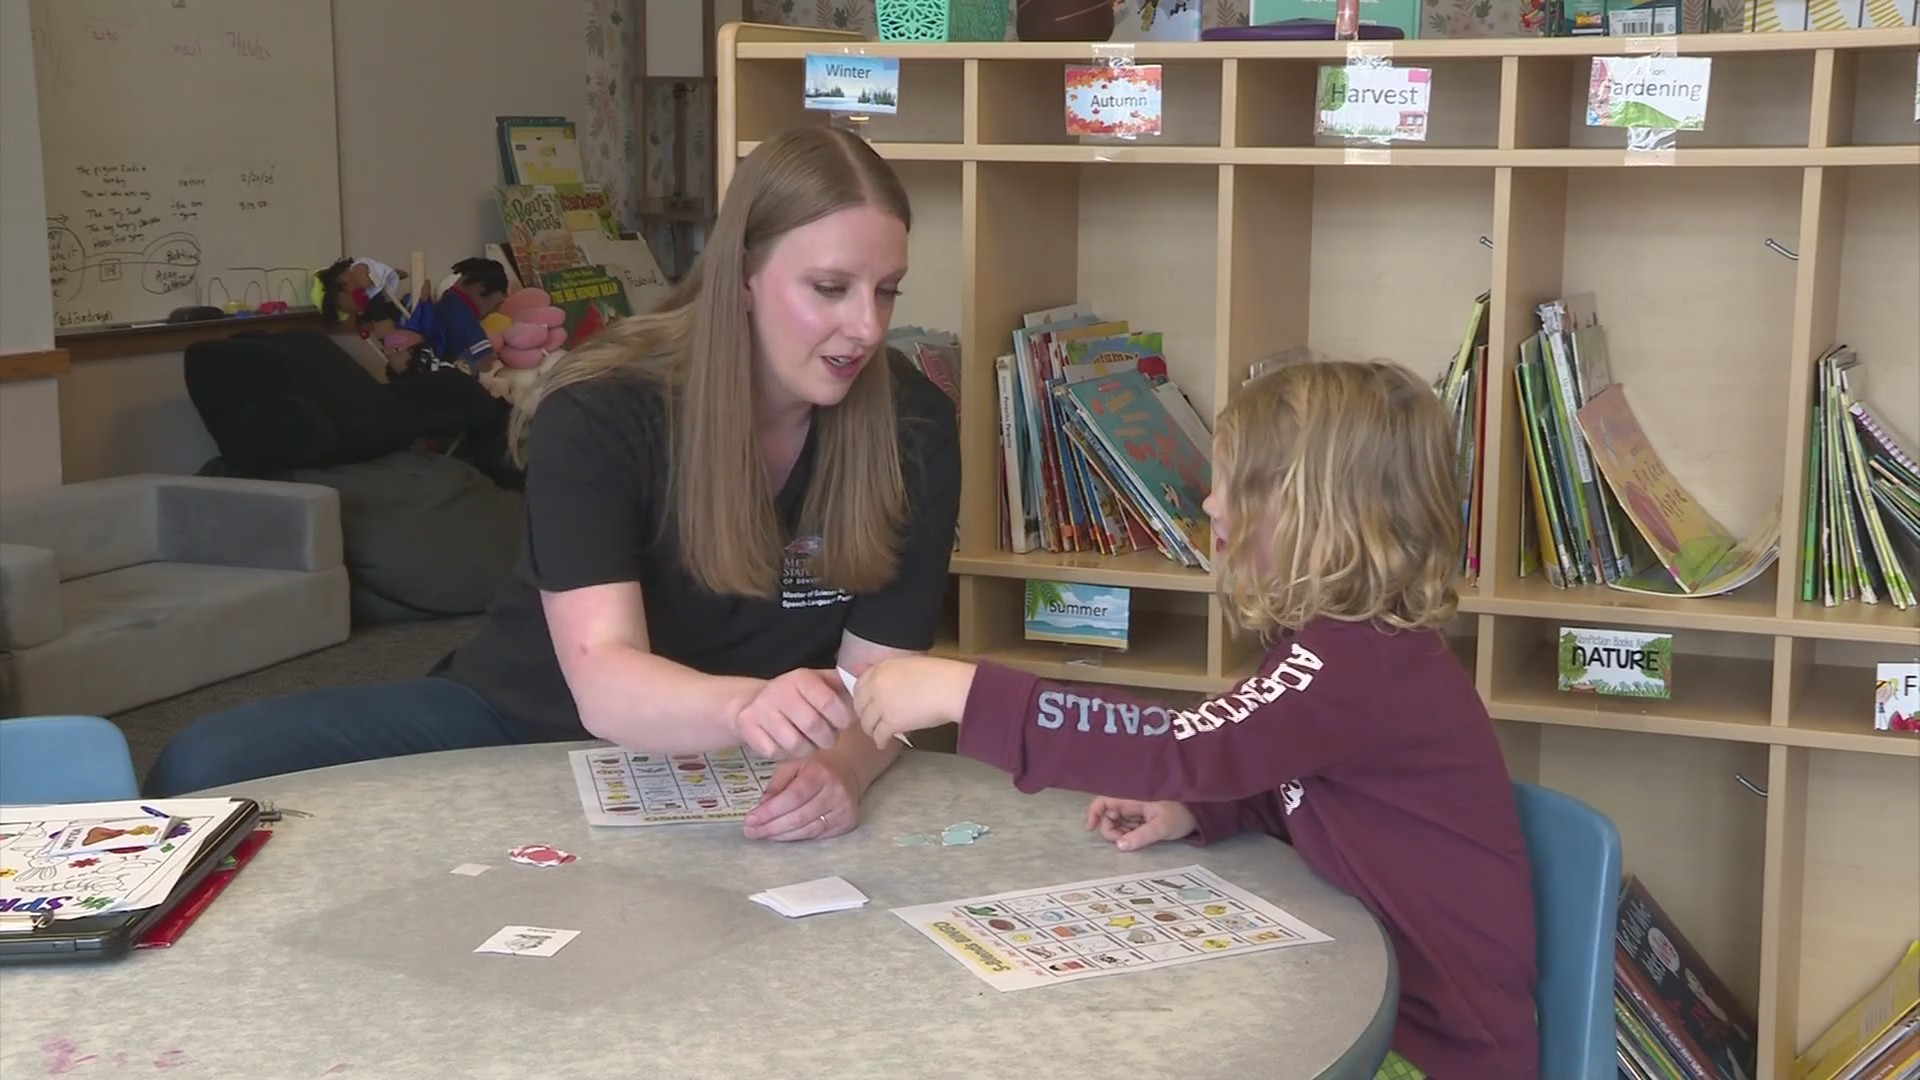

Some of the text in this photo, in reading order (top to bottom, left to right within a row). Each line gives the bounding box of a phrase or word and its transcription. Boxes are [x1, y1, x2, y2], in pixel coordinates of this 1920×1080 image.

[825, 63, 872, 79] Winter
[1330, 83, 1419, 105] Harvest
[1604, 79, 1703, 102] ardening
[1090, 95, 1148, 108] Autumn
[1049, 599, 1108, 617] Summer
[1037, 691, 1171, 737] CALLS
